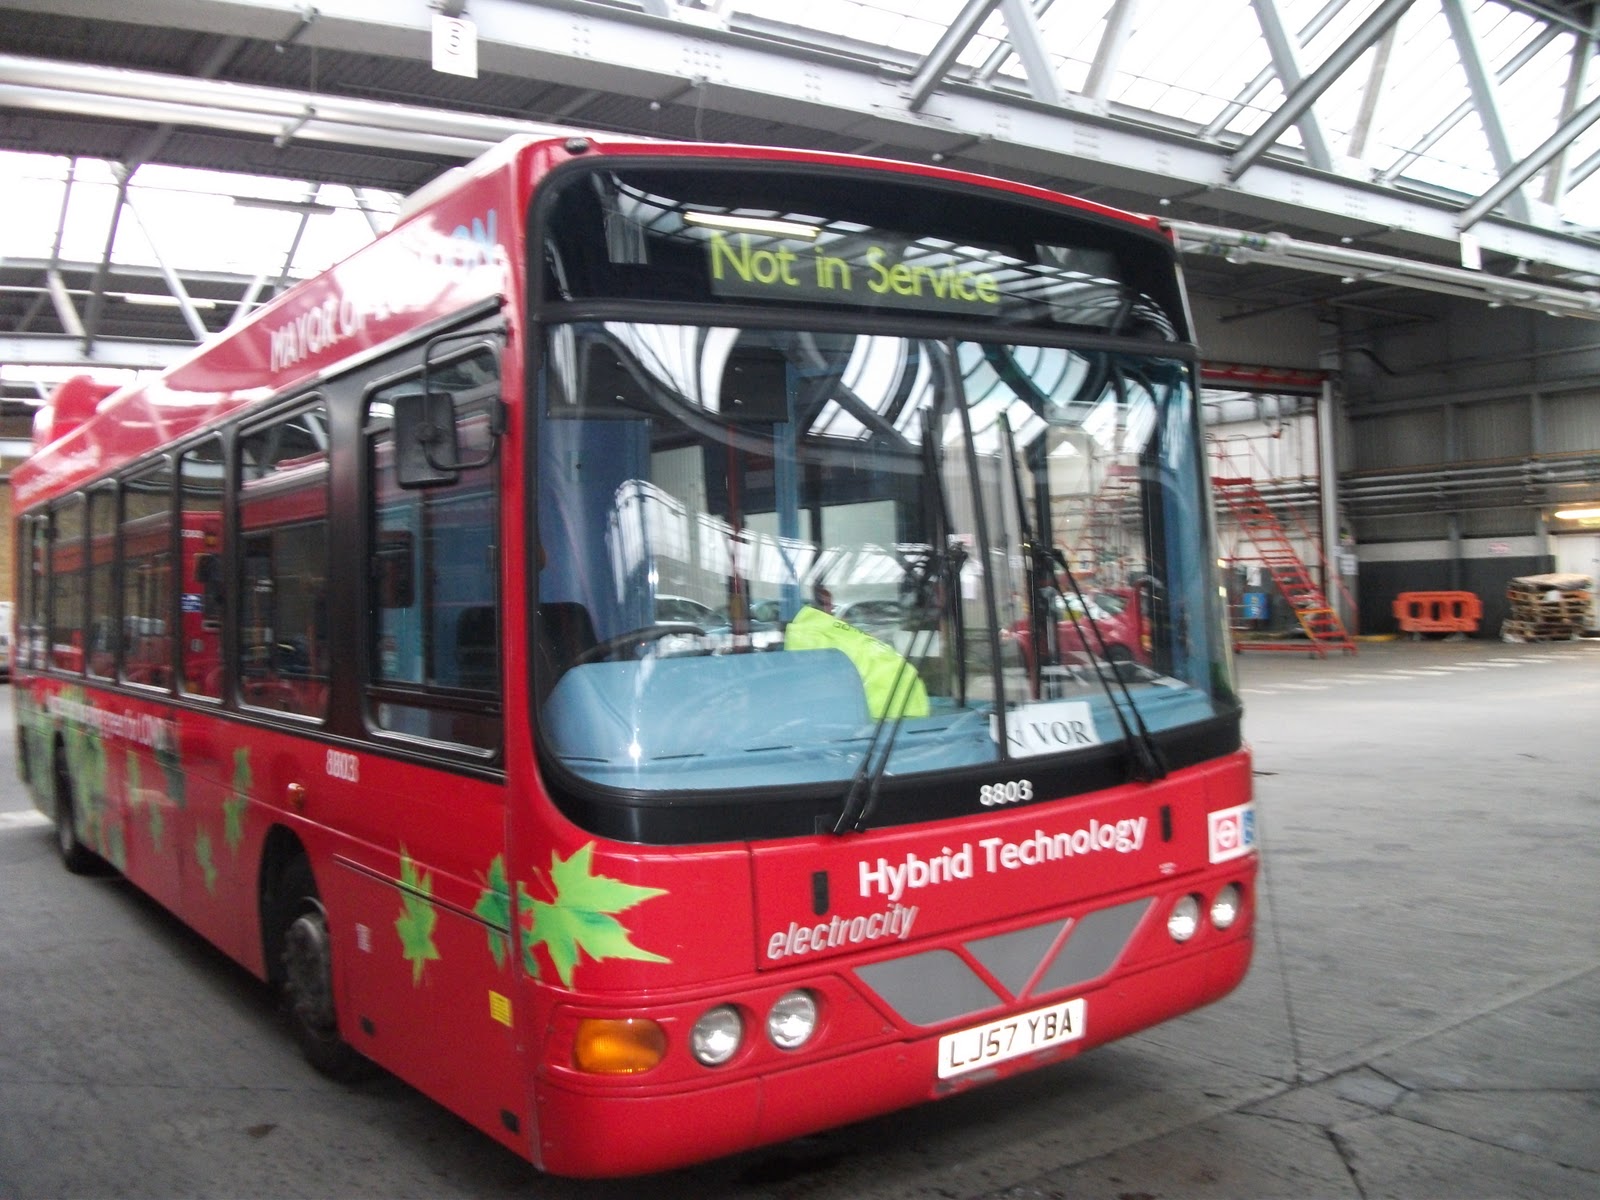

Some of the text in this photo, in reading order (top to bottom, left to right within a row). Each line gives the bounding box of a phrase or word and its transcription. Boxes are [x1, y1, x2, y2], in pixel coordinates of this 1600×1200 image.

[711, 232, 998, 303] Not in Service
[271, 296, 339, 373] MAYOR
[326, 748, 360, 783] 8803
[980, 779, 1033, 806] 8803
[859, 817, 1148, 901] Hybrid Technology
[767, 903, 919, 960] electrocity
[950, 1008, 1072, 1068] LJ57 YBA
